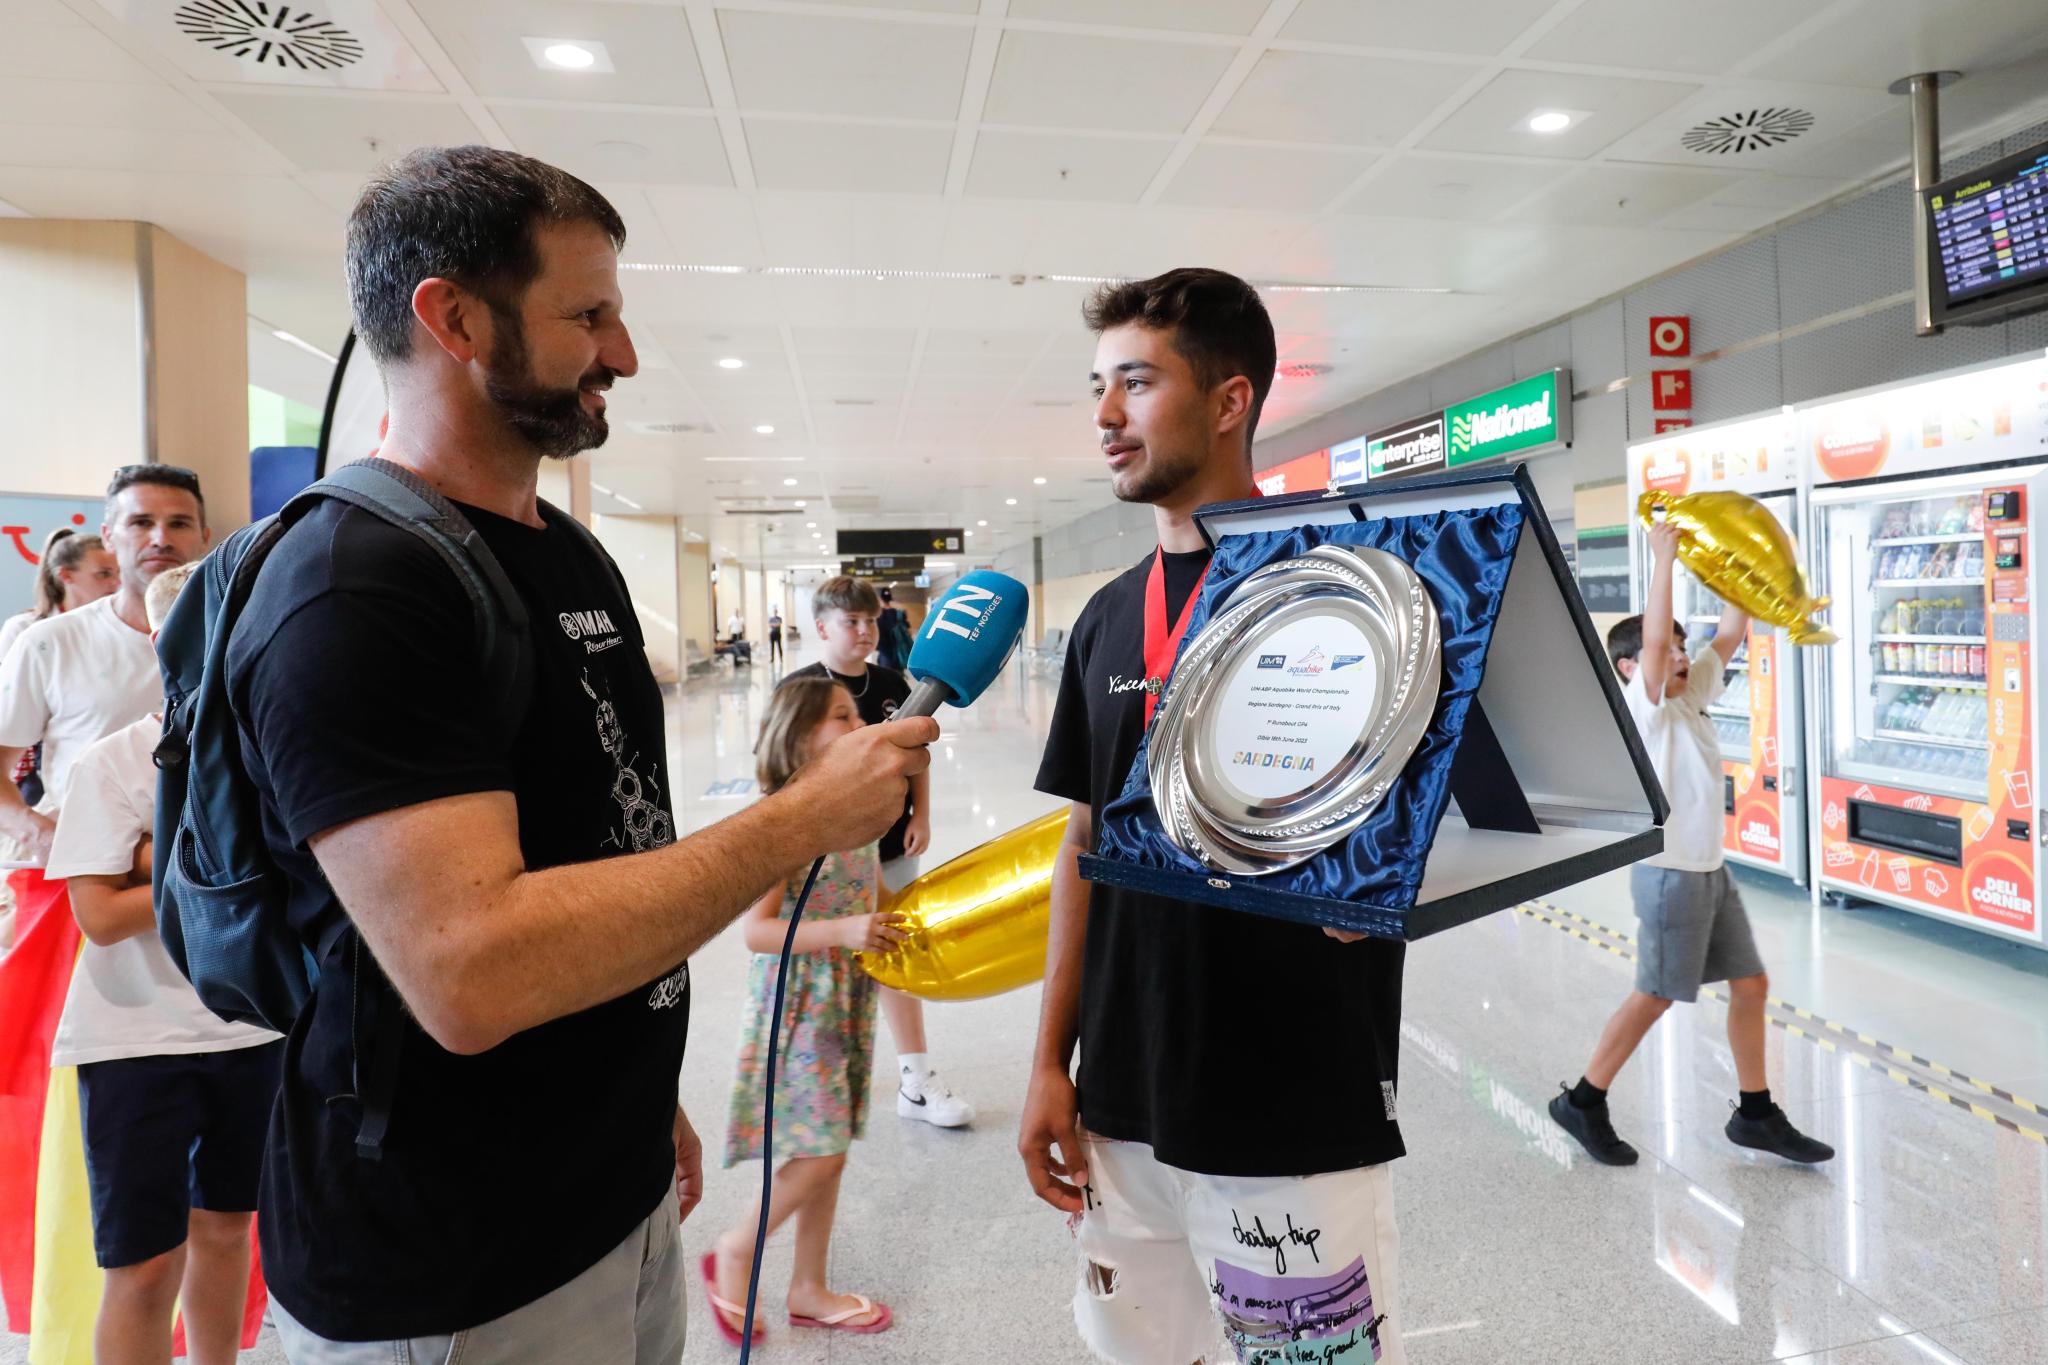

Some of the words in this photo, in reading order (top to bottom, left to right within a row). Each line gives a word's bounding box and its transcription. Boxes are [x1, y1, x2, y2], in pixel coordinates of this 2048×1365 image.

[925, 584, 995, 640] TN
[968, 627, 980, 642] TEF
[1287, 663, 1324, 679] aquabike
[1233, 751, 1315, 771] SARDEGNA
[1748, 821, 1770, 836] DELI
[1741, 830, 1779, 850] CORNER
[1985, 876, 2018, 896] DELI
[1971, 887, 2033, 915] CORNER
[1232, 1208, 1287, 1275] daily
